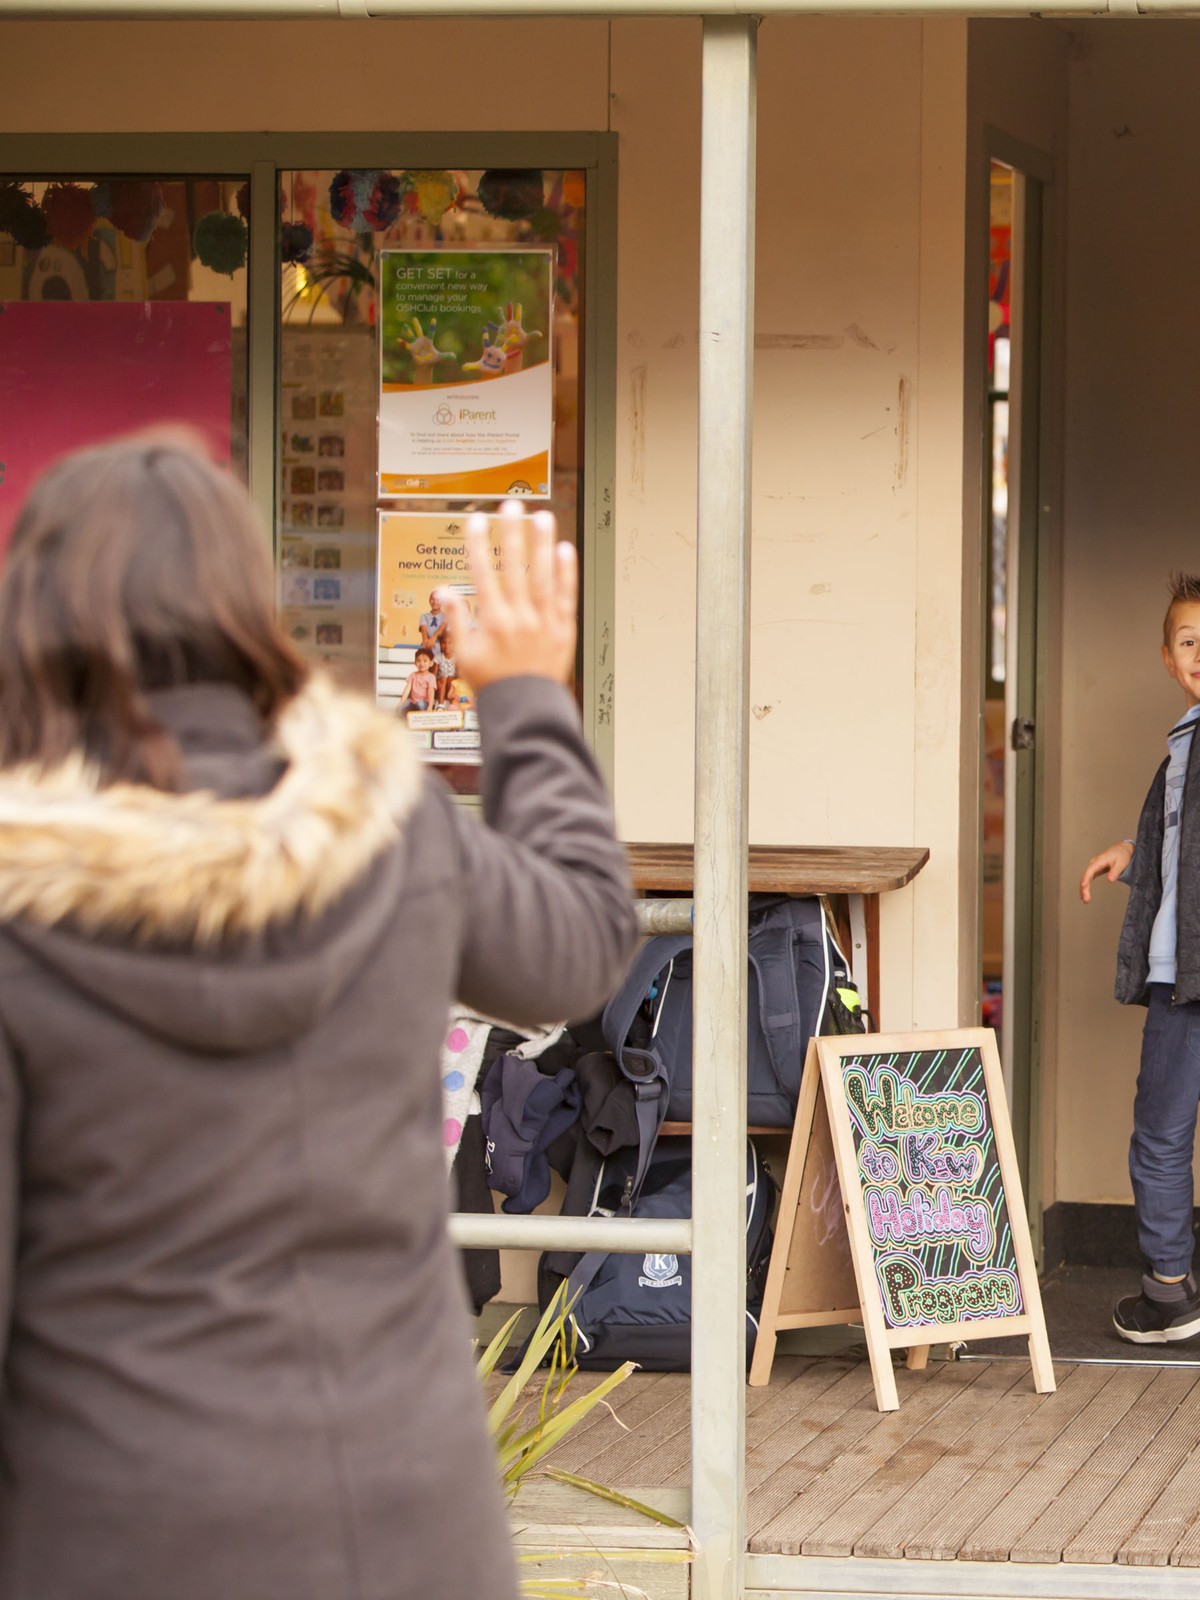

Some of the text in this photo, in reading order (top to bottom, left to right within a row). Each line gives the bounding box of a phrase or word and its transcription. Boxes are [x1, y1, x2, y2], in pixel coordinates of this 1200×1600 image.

[396, 267, 423, 279] GET
[427, 267, 452, 279] SET
[455, 270, 468, 279] for
[396, 282, 445, 290] convenient
[469, 283, 488, 291] way
[396, 293, 468, 303] to manage your
[396, 303, 481, 313] OSHClub bookings
[459, 408, 497, 420] iParent
[416, 543, 438, 555] Get
[398, 559, 472, 571] new Child Ca
[845, 1074, 981, 1135] Welcome
[860, 1131, 979, 1181] to Kew
[868, 1187, 991, 1257] Holiday
[654, 1253, 669, 1270] K
[880, 1259, 1017, 1323] Program
